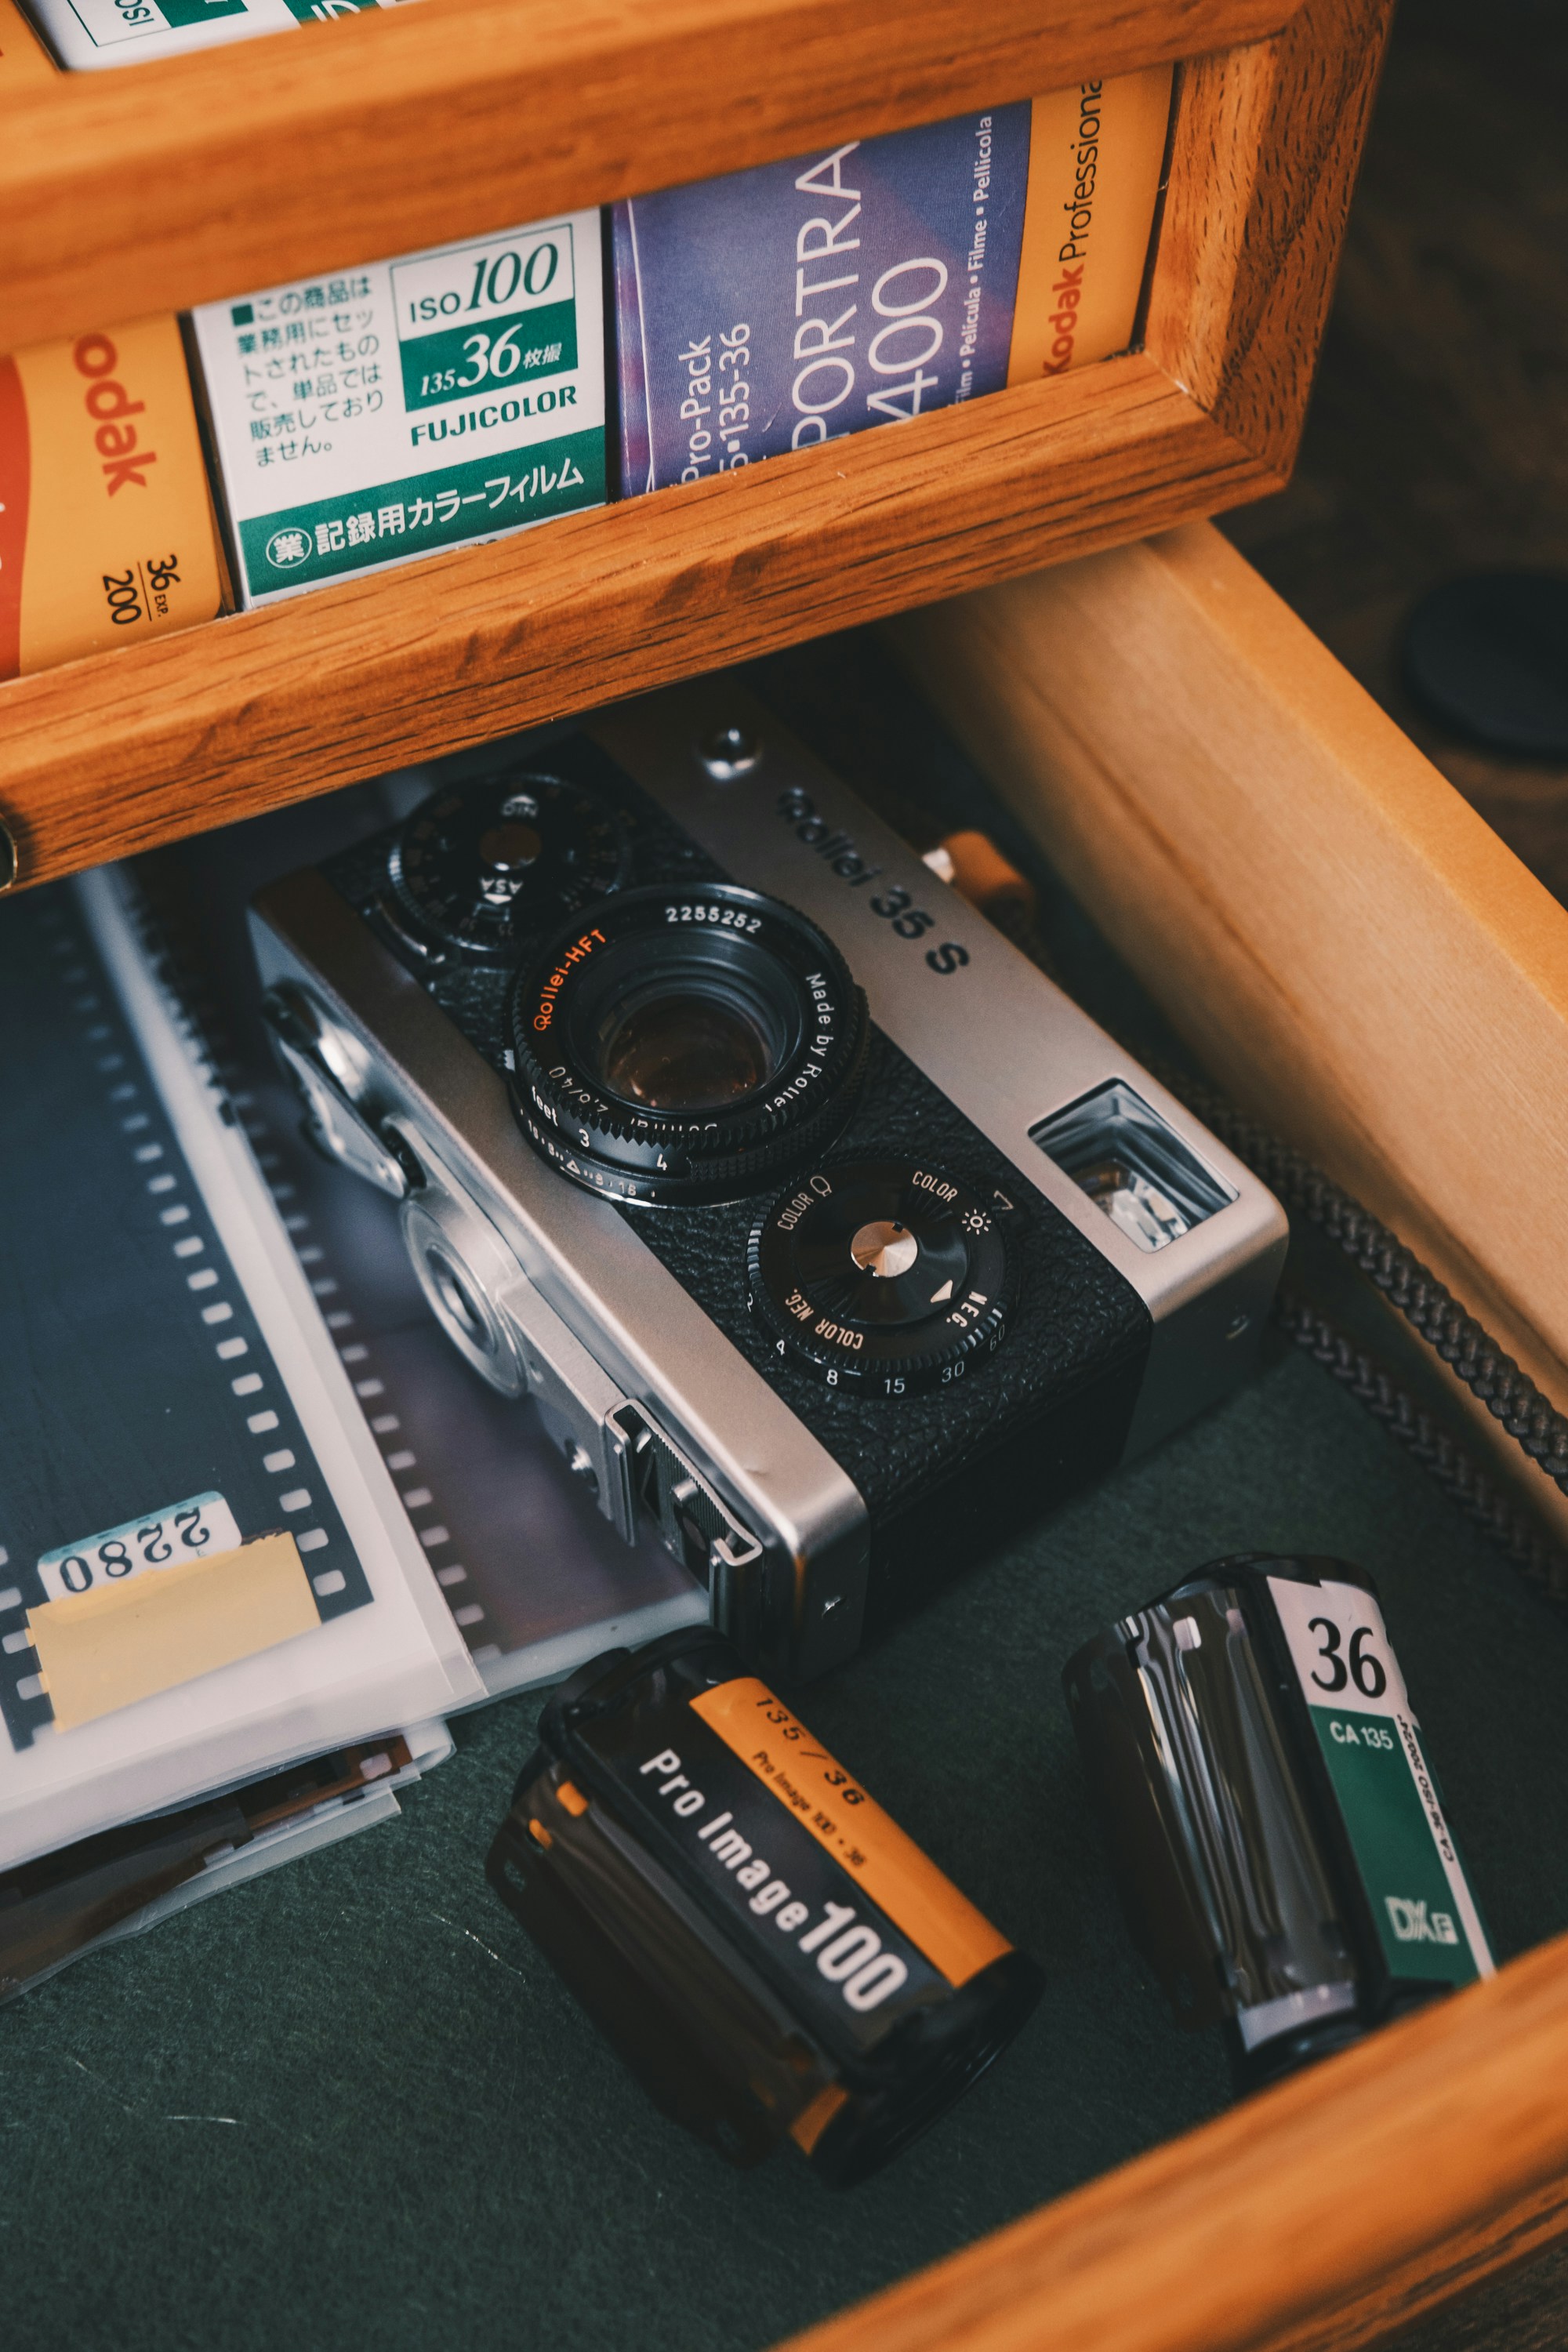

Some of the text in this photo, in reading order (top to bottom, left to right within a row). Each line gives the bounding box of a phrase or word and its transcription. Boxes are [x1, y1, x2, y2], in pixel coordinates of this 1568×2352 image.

[973, 116, 992, 202] Pellicola
[967, 219, 987, 271] Filme
[792, 141, 861, 451] PORTRA
[866, 257, 948, 421] 400
[411, 385, 577, 447] FUJICOLOR
[678, 335, 712, 483] Pro-Pack
[103, 569, 142, 625] 200
[147, 554, 180, 617] 36 EXP.
[480, 877, 523, 895] ASA
[777, 786, 970, 975] Rollei 35 S
[665, 906, 762, 933] 2255252
[534, 929, 606, 1031] Rollei-HFT
[806, 972, 834, 1025] Made
[810, 1035, 833, 1056] by
[532, 1085, 558, 1127] feet
[579, 1128, 667, 1171] 3 4
[619, 1183, 637, 1196] 16
[777, 1192, 815, 1231] COLOR
[912, 1171, 958, 1203] COLOR
[785, 1288, 864, 1350] COLOR NEG.
[946, 1290, 988, 1328] NEG.
[775, 1324, 1005, 1394] 4 8 15 30 60
[59, 1507, 210, 1593] 2280
[1308, 1617, 1387, 1698] 36
[1330, 1721, 1393, 1750] CA 135
[639, 1748, 706, 1817] Pro
[753, 1751, 775, 1774] Pro
[774, 1773, 811, 1811] Image
